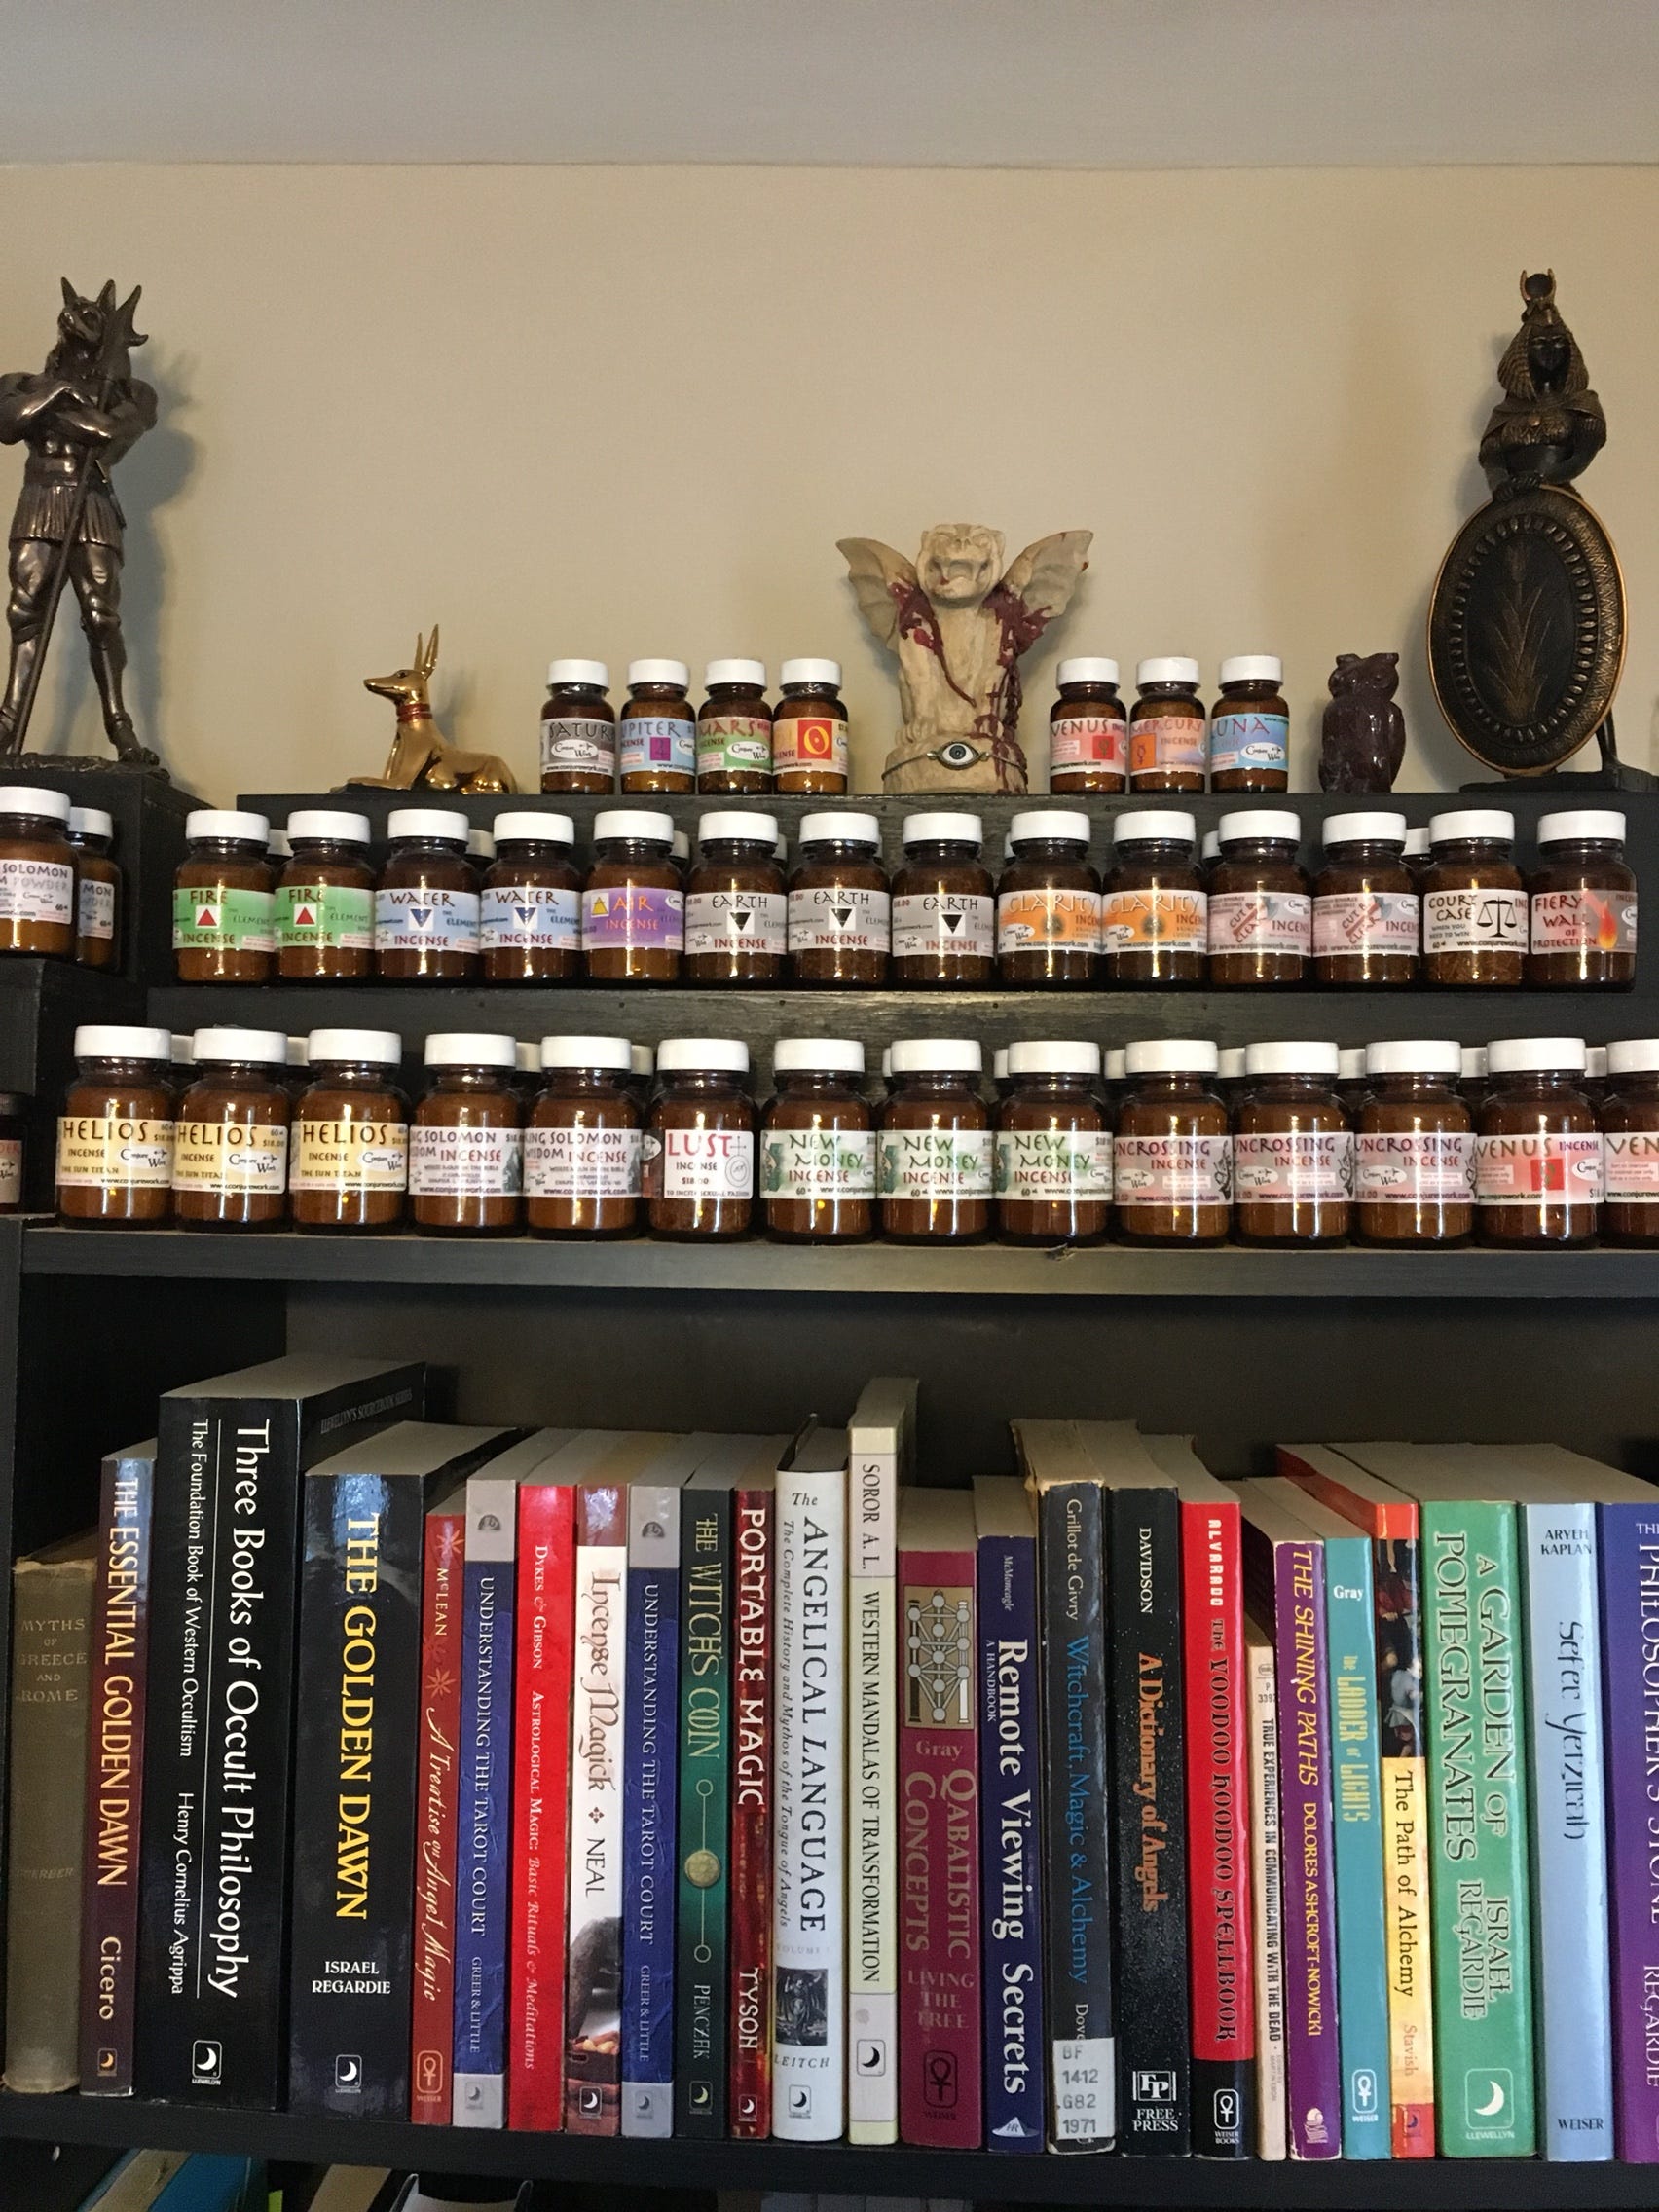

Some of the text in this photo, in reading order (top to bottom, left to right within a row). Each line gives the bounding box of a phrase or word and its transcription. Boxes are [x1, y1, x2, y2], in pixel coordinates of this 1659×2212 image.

[1051, 719, 1108, 738] VENUS
[2, 863, 68, 878] SOLOMON
[190, 889, 228, 904] FIRE
[389, 892, 455, 907] WATER
[712, 894, 768, 909] EARTH
[814, 890, 869, 905] EARTH
[922, 896, 978, 911] EARTH
[1009, 893, 1097, 916] CLARITY
[1428, 894, 1478, 910] COURT
[1535, 895, 1583, 911] FIERY
[1436, 909, 1472, 921] CASE
[182, 932, 235, 944] INCENSE
[1532, 938, 1597, 949] PROTECTIN
[62, 1120, 148, 1142] HELIOS
[177, 1124, 257, 1147] HELIOS
[302, 1124, 388, 1145] HELIOS
[550, 1132, 623, 1145] SOLOMON
[667, 1133, 733, 1158] LUST
[903, 1135, 954, 1152] NEW
[1014, 1134, 1066, 1151] NEW
[1477, 1137, 1552, 1158] VENUS
[909, 1155, 978, 1169] MONEY
[791, 1492, 819, 1506] The
[862, 1463, 881, 1570] SOROR A. L.
[1545, 1528, 1589, 1541] ARYEH
[1540, 1543, 1592, 1556] KAPLAN
[1333, 1585, 1364, 1601] Gray
[802, 1516, 829, 1725] ANGELICAL
[1557, 1621, 1584, 1700] Sefer
[36, 1674, 61, 1682] AND
[20, 1689, 80, 1704] ROME
[1434, 1531, 1477, 1862] POMEGRANATES
[1476, 1555, 1516, 1836] A GARDEN OF
[169, 1419, 209, 1995] The Foundation Book of Western Occultism Henry Cornelius Agrippa
[207, 1419, 270, 1999] Three Books of Occult Philosophy
[336, 1511, 381, 1920] THE GOLDEN DAWN
[778, 1520, 794, 1927] The Complete History and Mythos of the Tongue of Angels
[1131, 1528, 1169, 1913] DAVIDSON A Dictionary of Angels
[579, 1570, 623, 1898] Incense Magick NEAL
[1262, 1718, 1275, 1749] TRUE
[97, 1479, 139, 2020] THE ESSENTIAL GOLDEN DAWN Cicero
[915, 1739, 963, 1763] Gray
[736, 1508, 767, 2051] PORTABLE MAGIC TYSON
[1065, 1498, 1094, 2040] Grillot de Givry Witchcraft, Magic & Alchemy Dove
[861, 1591, 881, 1983] WESTERN MANDALAS OF TRANSFORMATION
[1263, 1751, 1277, 1828] EXPERIENCES
[1293, 1549, 1322, 2037] THE SHINING PATHS DOLORES ASHCROFT-NOWICKI
[469, 1576, 495, 2053] UNDERSTANDING THE TAROT COURT GREER & LITTLE
[799, 1735, 828, 1933] LANGUAGE
[1265, 1831, 1275, 1845] IN
[904, 1771, 937, 1952] CONCEPTS
[940, 1769, 977, 1959] QABALISTIC
[992, 1639, 1034, 2094] Remote Viewing Secrets
[1265, 1848, 1279, 1950] COMMUNICATING
[1394, 1770, 1419, 2077] The Path of Alchemy Stavish
[1452, 1878, 1488, 2020] REGARDIE
[1485, 1896, 1512, 2002] ISRAEL
[324, 1961, 380, 1975] ISRAEL
[312, 1979, 391, 1994] REGARDIE
[907, 1971, 975, 1989] LIVING
[919, 1992, 962, 2009] THE
[1267, 1985, 1280, 2007] THE
[917, 2011, 969, 2029] TREE
[1269, 2011, 1282, 2042] DEAD
[774, 2056, 830, 2068] LEITCH
[1062, 2046, 1084, 2060] BF
[1062, 2070, 1099, 2084] 1412
[1136, 2108, 1174, 2120] FREE
[1558, 2117, 1604, 2130] WEISER
[1063, 2119, 1096, 2134] 1971
[1132, 2120, 1179, 2132] PRESS
